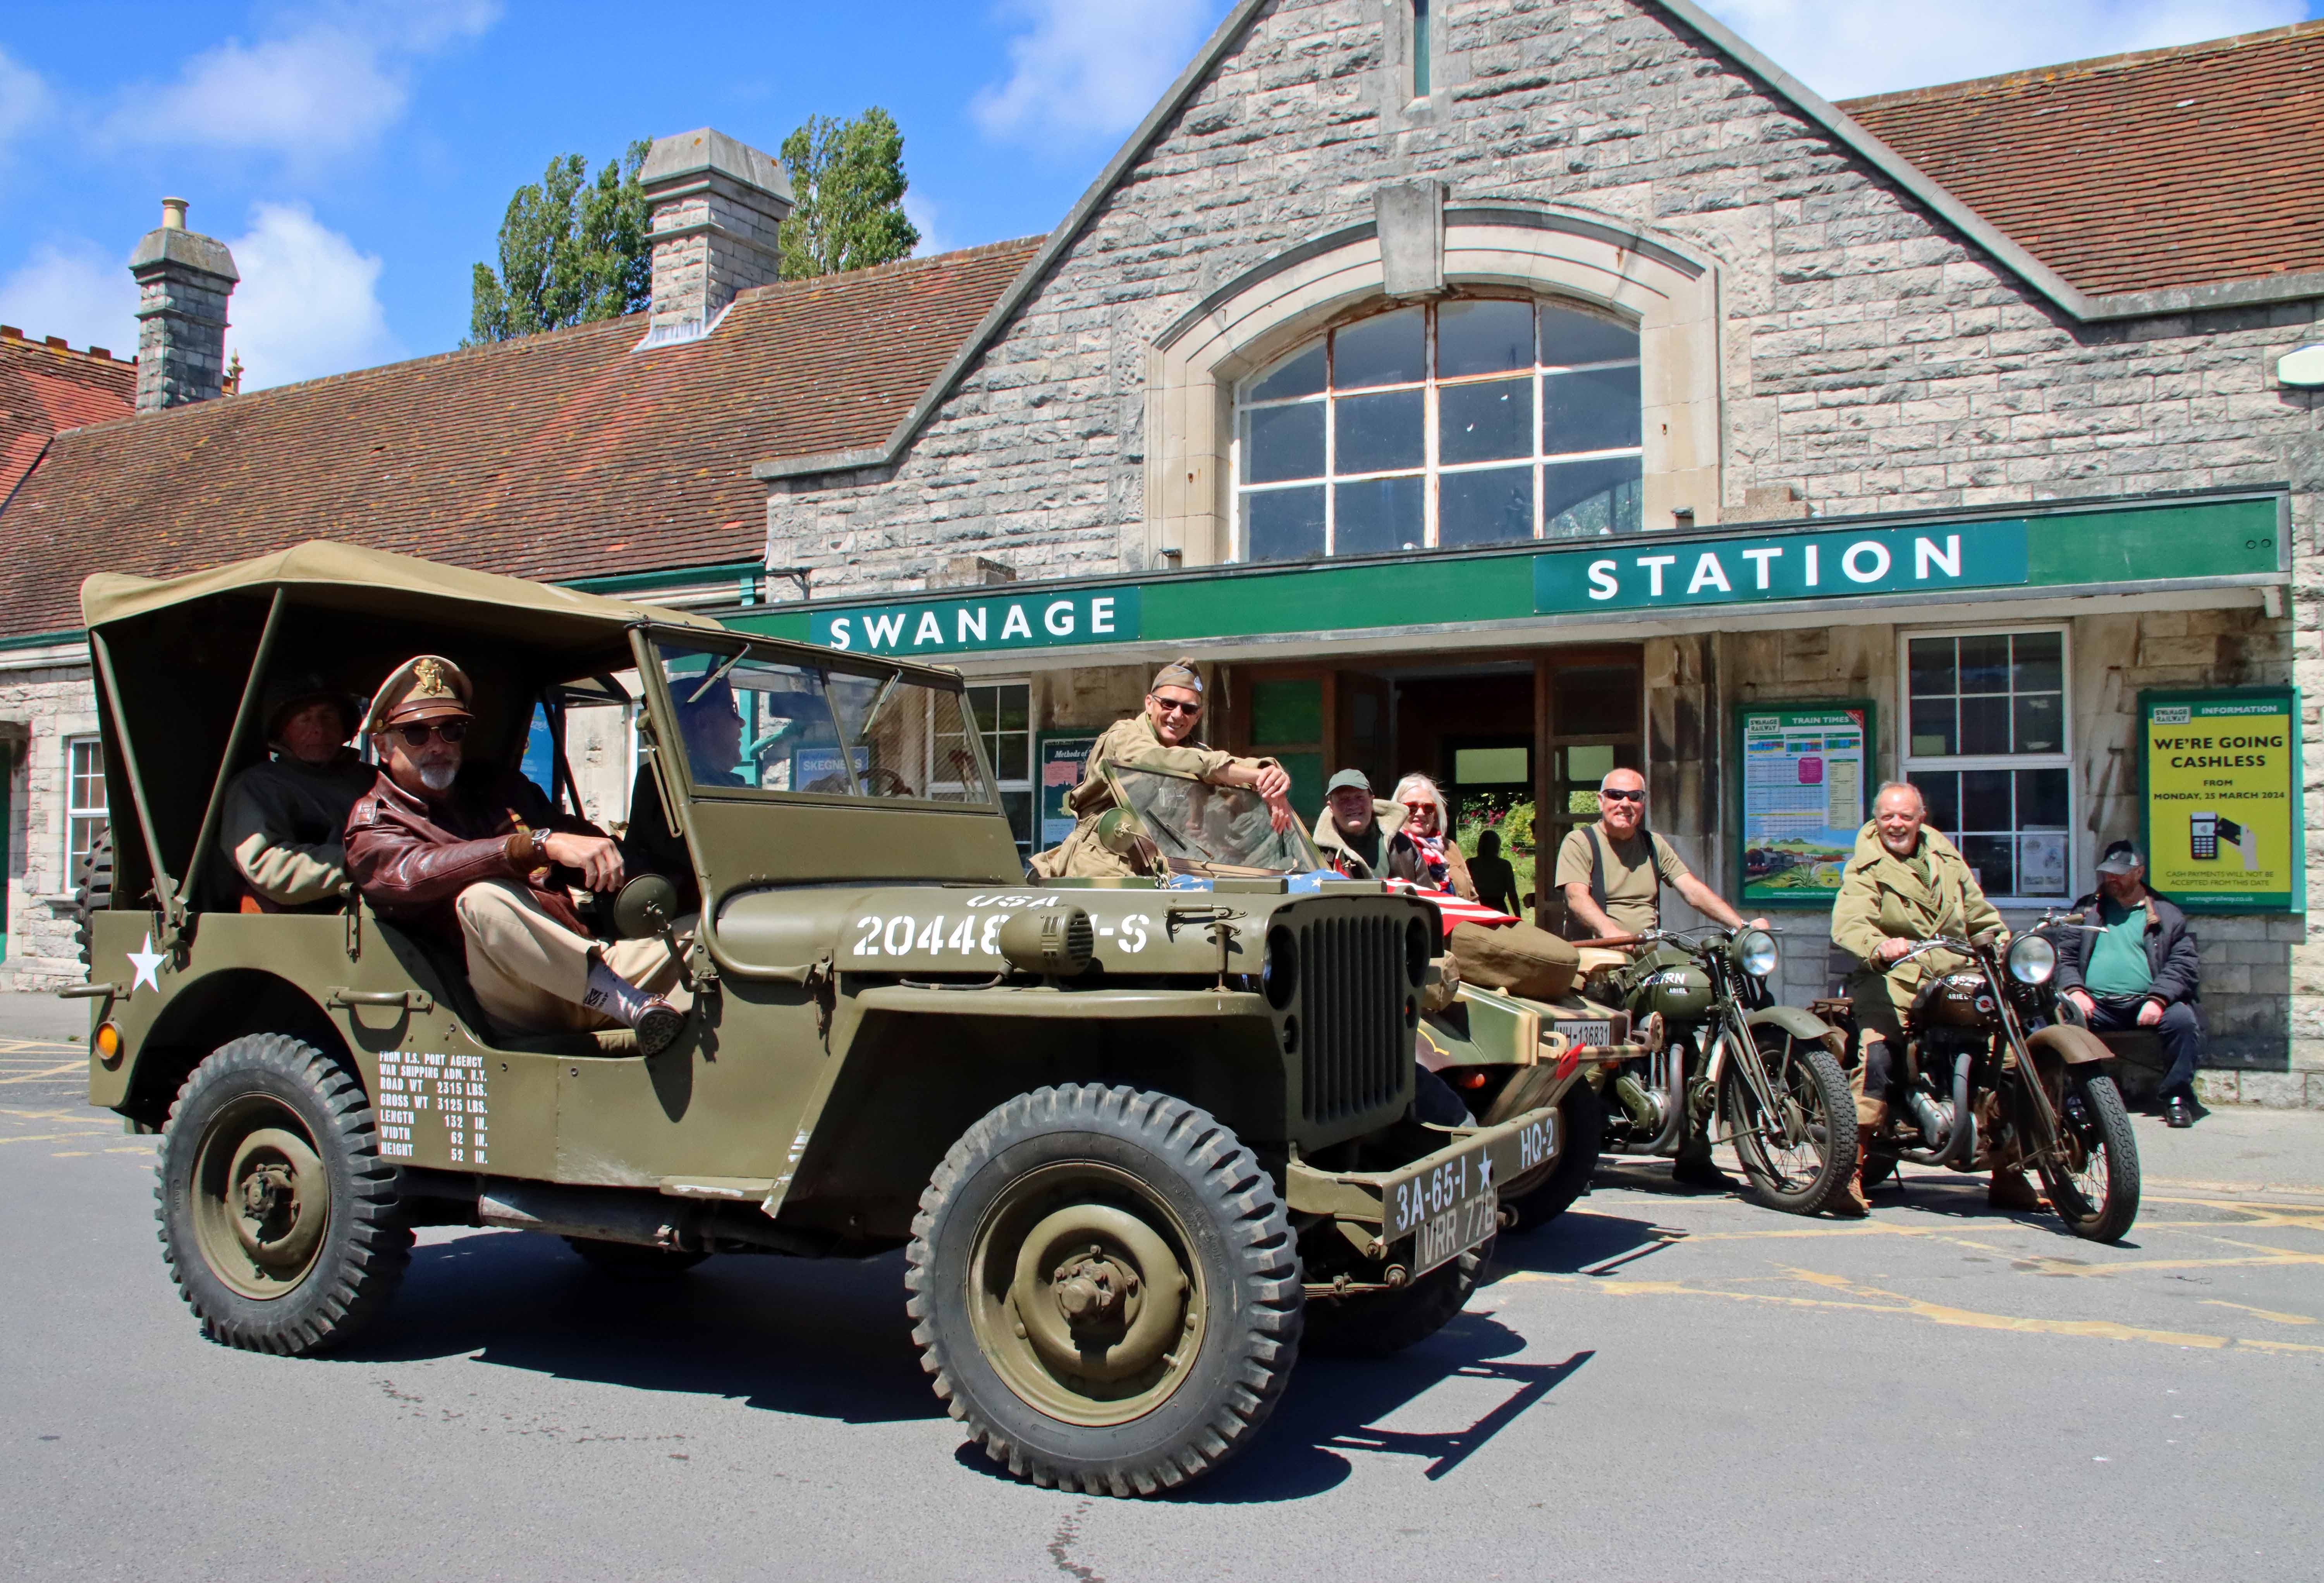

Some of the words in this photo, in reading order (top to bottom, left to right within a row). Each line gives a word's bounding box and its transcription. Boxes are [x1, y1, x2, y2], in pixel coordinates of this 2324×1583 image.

[1587, 535, 1961, 600] STATION
[830, 597, 1115, 650] SWANAGE
[2202, 705, 2277, 714] INFORMATION
[2154, 738, 2213, 750] WE'RE
[2219, 736, 2282, 748] GOING
[803, 758, 862, 771] SKEGNES
[2171, 755, 2266, 768] CASHLESS
[966, 896, 1059, 907] USA
[379, 1051, 400, 1063] FROM
[405, 1052, 420, 1064] U.S.
[425, 1053, 445, 1065] PORT
[450, 1055, 483, 1067] AGENCY
[379, 1064, 396, 1076] WAR
[401, 1065, 439, 1079] SHIPPING
[443, 1068, 466, 1080] ADM.
[471, 1070, 487, 1082] N.Y.
[380, 1077, 404, 1091] ROAD
[409, 1079, 423, 1092] WT
[437, 1081, 462, 1094] 2315
[466, 1083, 487, 1097] LBS.
[380, 1093, 409, 1107] GROSS
[414, 1095, 428, 1109] WT
[437, 1098, 463, 1111] 3125
[467, 1099, 488, 1113] LBS.
[380, 1110, 414, 1124] LENGTH
[445, 1115, 463, 1128] 132
[474, 1117, 488, 1130] IN.
[380, 1125, 410, 1140] WIDTH
[451, 1132, 463, 1144] 62
[474, 1134, 488, 1147] IN.
[1521, 1118, 1554, 1169] HQ-2
[380, 1142, 413, 1156] HEIGHT
[451, 1148, 464, 1161] 52
[474, 1150, 488, 1164] IN.
[1424, 1209, 1456, 1265] VRR
[1465, 1189, 1494, 1243] 776
